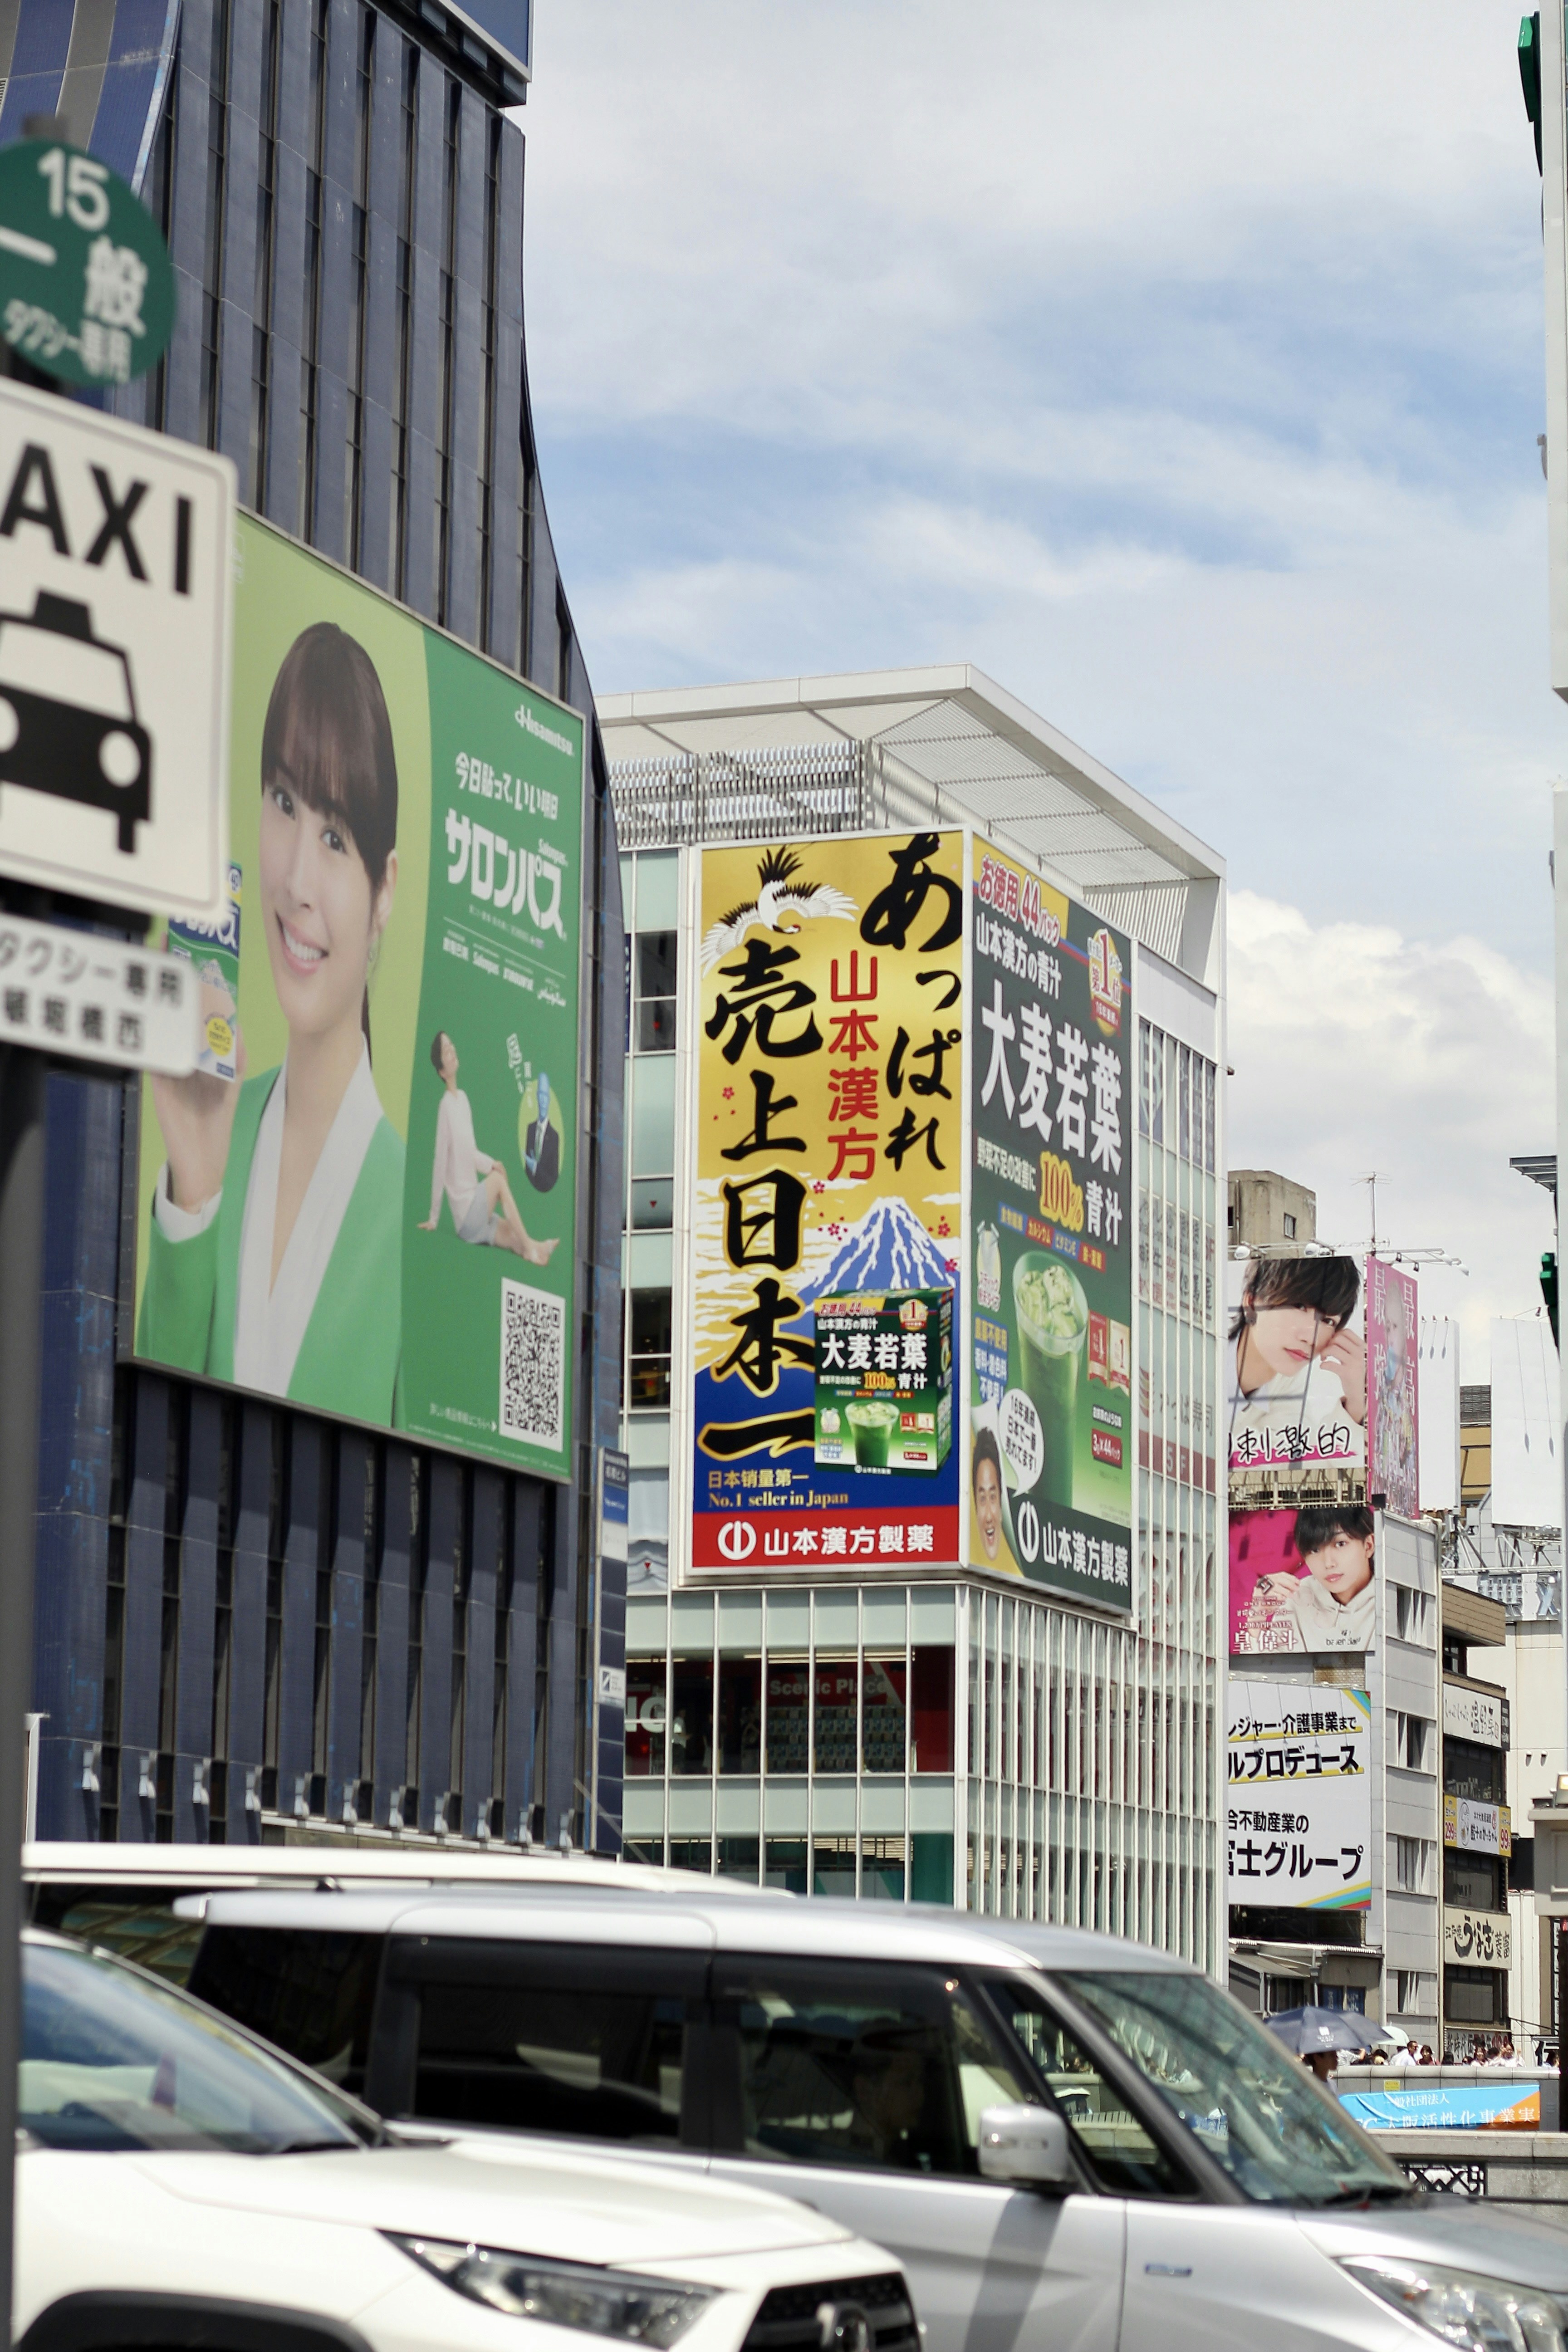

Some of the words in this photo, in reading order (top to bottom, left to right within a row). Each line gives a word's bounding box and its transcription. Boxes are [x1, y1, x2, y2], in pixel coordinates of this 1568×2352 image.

[38, 146, 110, 230] 15
[445, 807, 564, 940] サロンパス
[978, 854, 1020, 922] お徳用
[976, 911, 1062, 999] 山本漢方の青汁
[860, 833, 962, 1171] あっぱれ
[828, 950, 878, 1181] 山本漢方
[980, 978, 1122, 1176] 大麦若葉
[702, 939, 823, 1454] 売上日本一
[977, 1136, 1036, 1192] 野菜不足の改善に
[1042, 1154, 1084, 1229] 100%
[1086, 1180, 1123, 1245] 青汁
[821, 1333, 927, 1370] 大麦若葉
[864, 1371, 897, 1390] 100%
[897, 1372, 928, 1390] 青汁
[708, 1468, 809, 1489] 日本销量第一
[748, 1491, 788, 1507] seller
[789, 1490, 804, 1505] in
[806, 1490, 848, 1509] Japan
[764, 1524, 934, 1556] 山本漢方製薬
[1043, 1521, 1129, 1587] 山本漢方製薬
[1455, 1913, 1494, 1961] うなぎ
